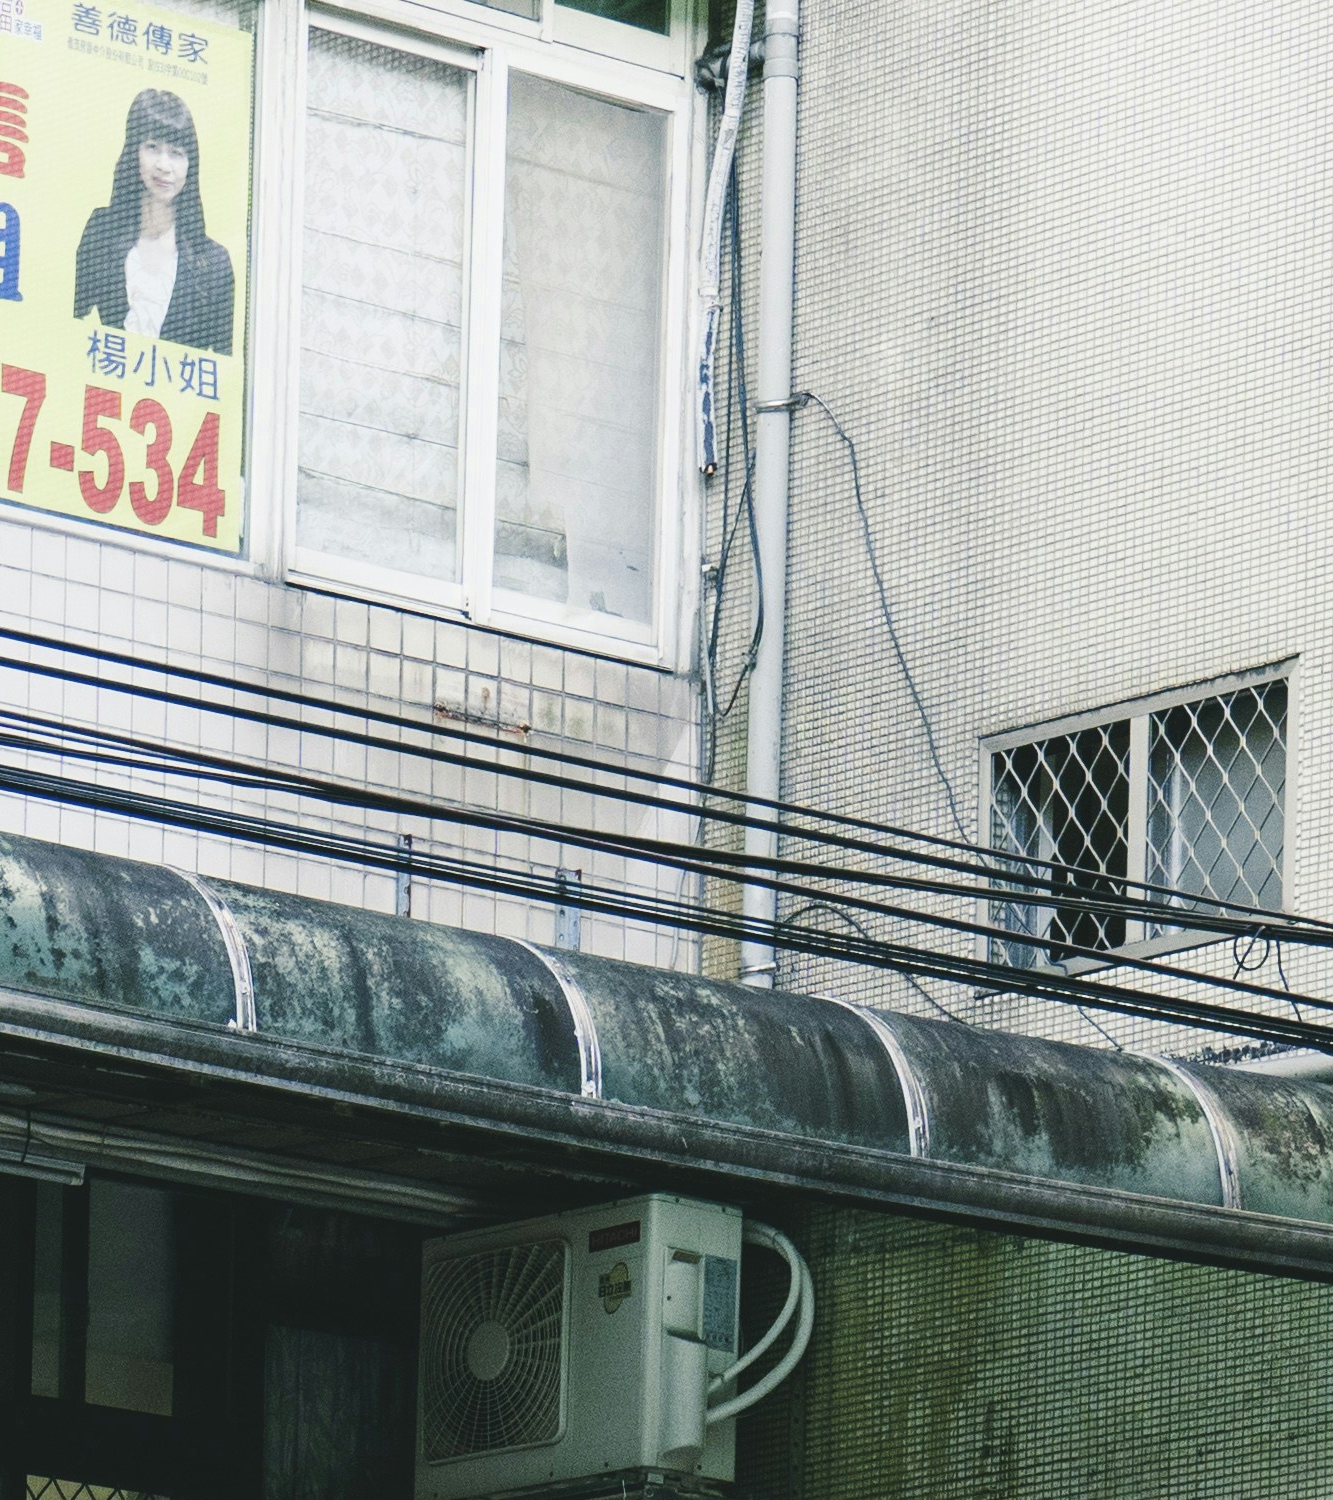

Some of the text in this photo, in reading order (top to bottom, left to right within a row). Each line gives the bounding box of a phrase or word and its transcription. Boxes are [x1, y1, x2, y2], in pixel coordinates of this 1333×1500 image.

[71, 3, 208, 65] 善德傳家
[86, 328, 221, 401] 楊小姐
